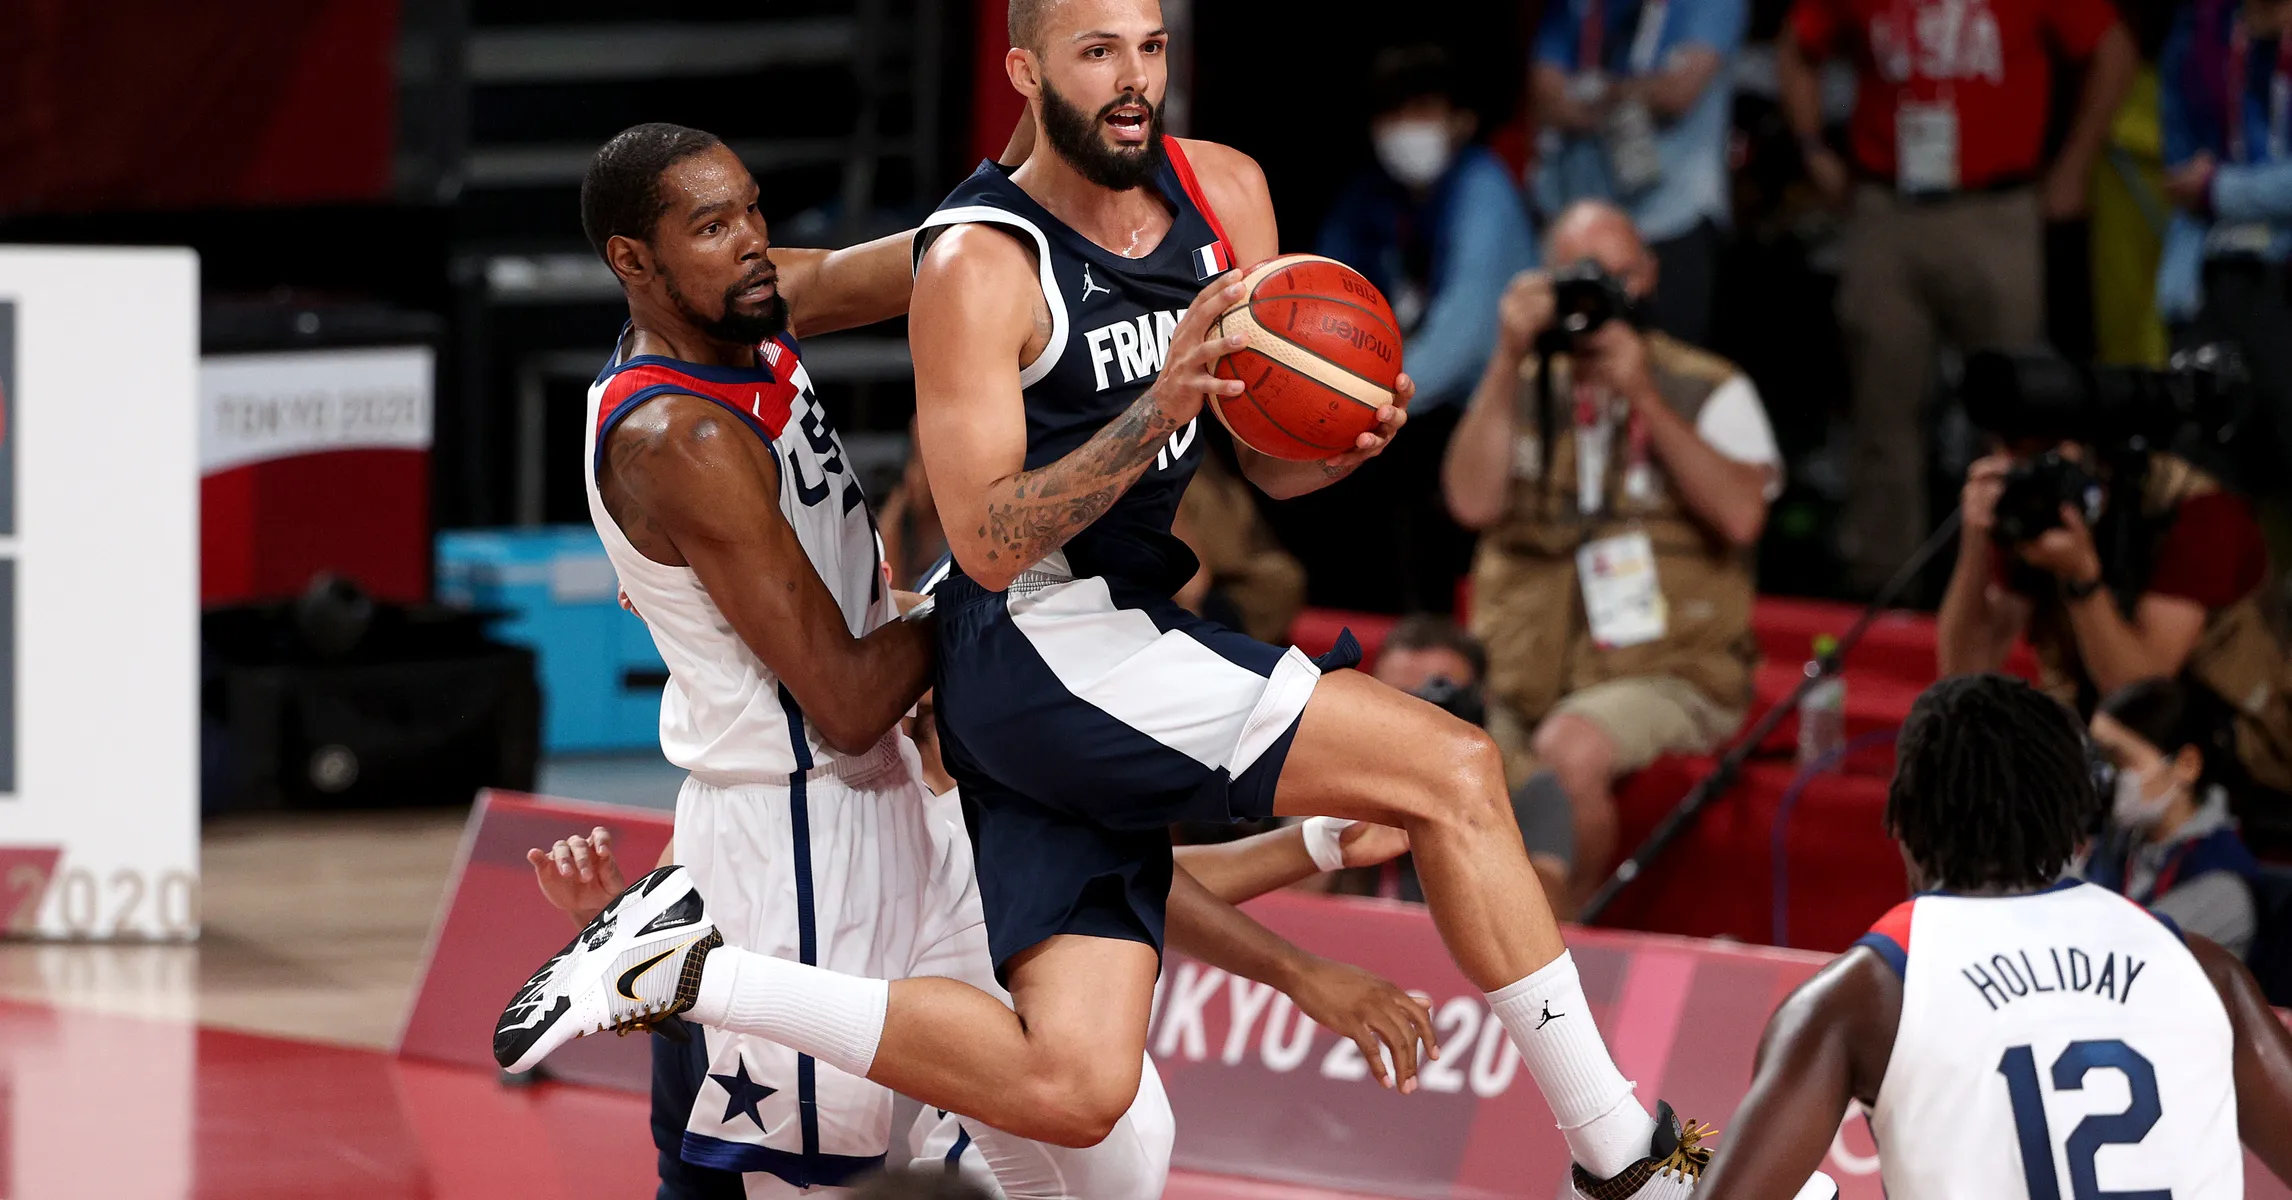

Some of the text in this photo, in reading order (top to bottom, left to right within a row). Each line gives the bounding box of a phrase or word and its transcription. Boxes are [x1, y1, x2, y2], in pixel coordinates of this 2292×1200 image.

[1341, 278, 1378, 306] FIBA
[1321, 316, 1392, 364] molten
[7, 866, 201, 937] 2020
[1961, 947, 2146, 1012] HOLIDAY
[1996, 1038, 2174, 1200] 12
